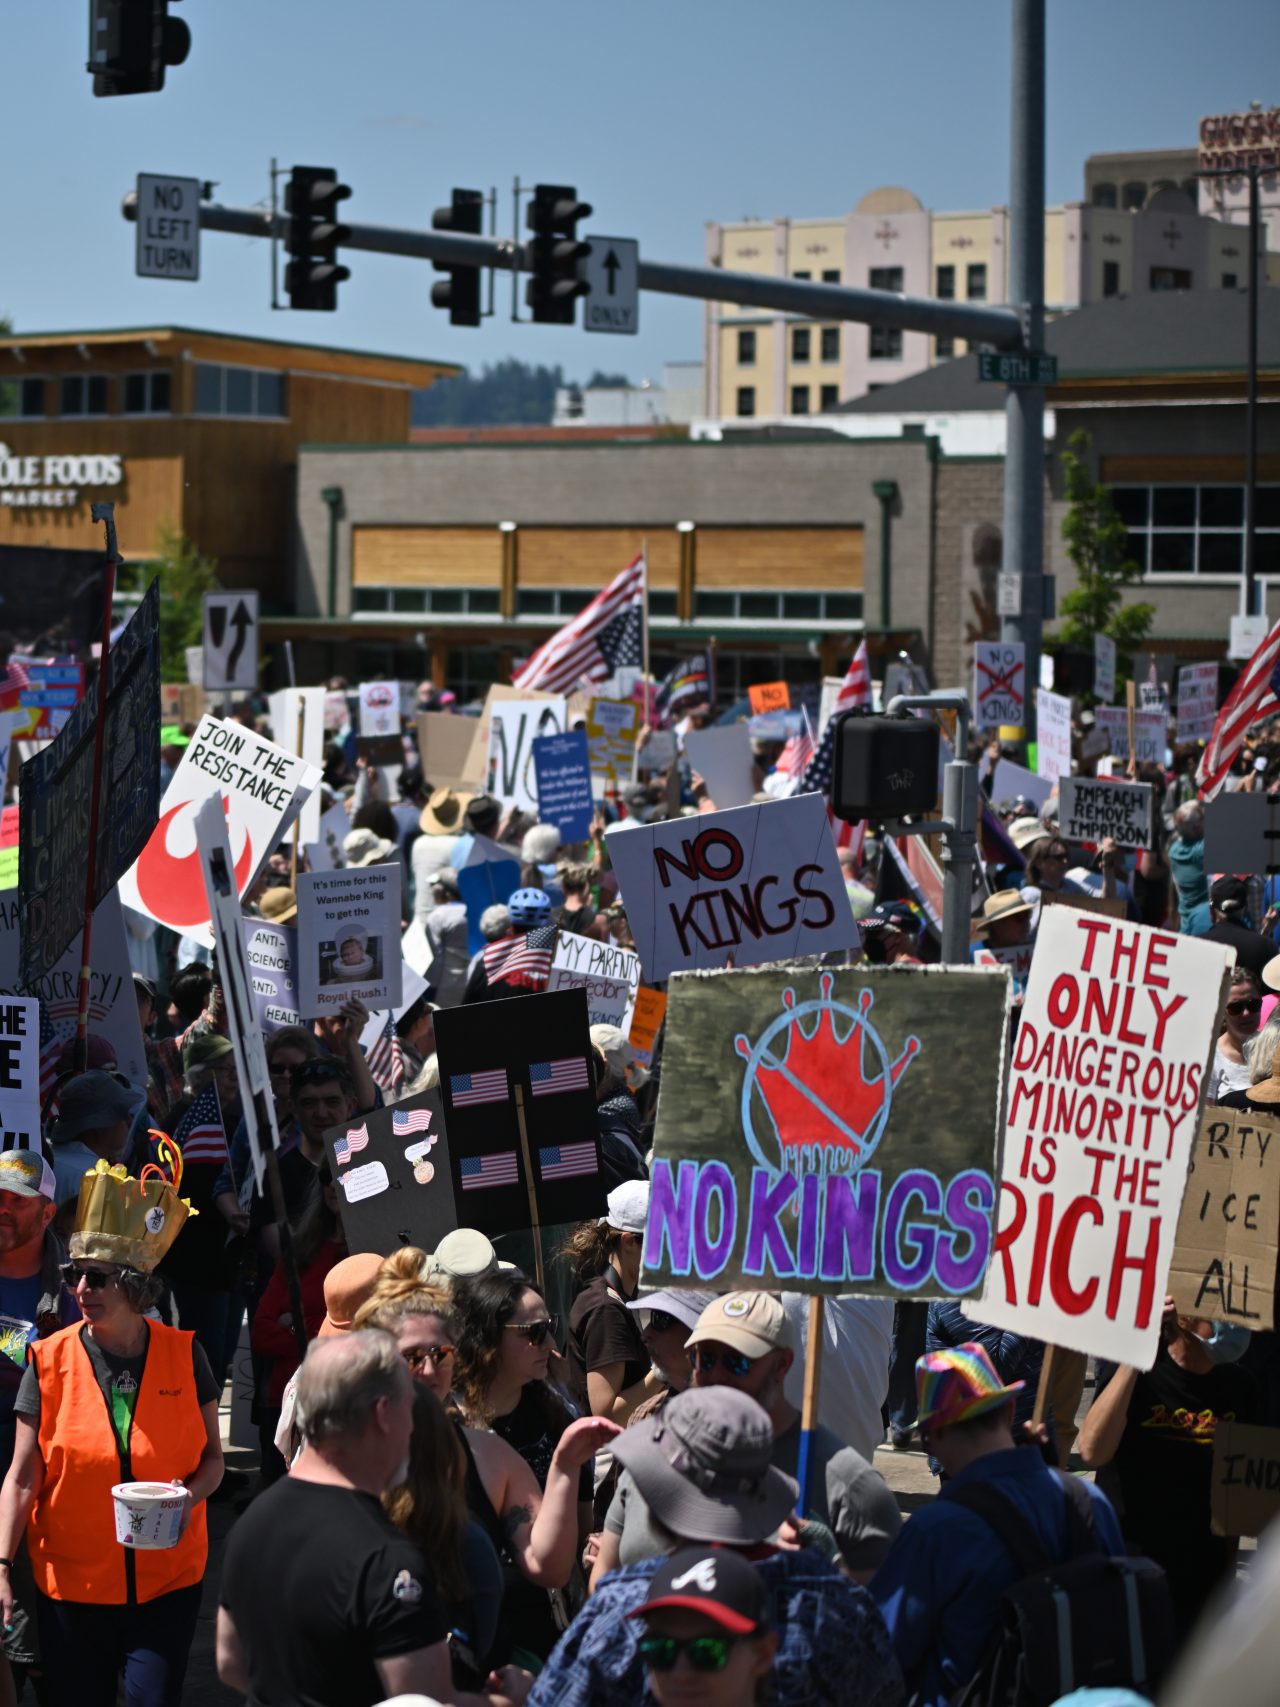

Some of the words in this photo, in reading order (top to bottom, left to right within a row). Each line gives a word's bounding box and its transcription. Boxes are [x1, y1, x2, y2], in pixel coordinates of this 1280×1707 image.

[154, 186, 183, 211] NO
[146, 217, 192, 241] LEFT
[144, 245, 193, 270] TURN
[592, 305, 632, 326] ONLY
[982, 356, 993, 379] E
[1001, 357, 1030, 380] 8TH
[44, 454, 122, 486] FOODS
[0, 489, 79, 506] MARKET
[989, 649, 1015, 666] NO
[761, 689, 783, 700] NO
[982, 701, 1021, 721] KINGS
[200, 722, 246, 756] JOIN
[253, 745, 295, 780] THE
[189, 743, 293, 812] RESISTANCE
[1074, 785, 1143, 809] IMPEACH
[1074, 803, 1135, 826] REMOVE
[1068, 820, 1149, 845] IMPRISON
[653, 828, 744, 888] NO
[313, 880, 328, 890] It's
[330, 879, 352, 889] time
[353, 877, 368, 887] for
[368, 874, 387, 885] this
[316, 892, 362, 905] Wannabe
[363, 889, 385, 902] King
[325, 911, 335, 920] to
[337, 910, 352, 921] get
[353, 907, 370, 918] the
[669, 863, 835, 957] KINGS
[255, 932, 286, 948] ANTI-
[247, 951, 290, 971] SCIENCE
[560, 933, 587, 970] MY
[588, 943, 640, 988] PARENTS
[1077, 918, 1178, 990] THE
[252, 979, 277, 995] ANTI-
[317, 990, 348, 1005] Royal
[351, 987, 382, 1001] Flush
[1047, 972, 1189, 1053] ONLY
[1013, 1021, 1203, 1112] DANGEROUS
[1007, 1076, 1188, 1160] MINORITY
[1020, 1135, 1058, 1184] IS
[1084, 1147, 1163, 1207] THE
[1200, 1189, 1262, 1231] ICE
[643, 1157, 738, 1280] NO
[742, 1165, 995, 1294] KINGS
[995, 1180, 1162, 1330] RICH
[1195, 1258, 1261, 1320] ALL
[1223, 1455, 1280, 1487] IND
